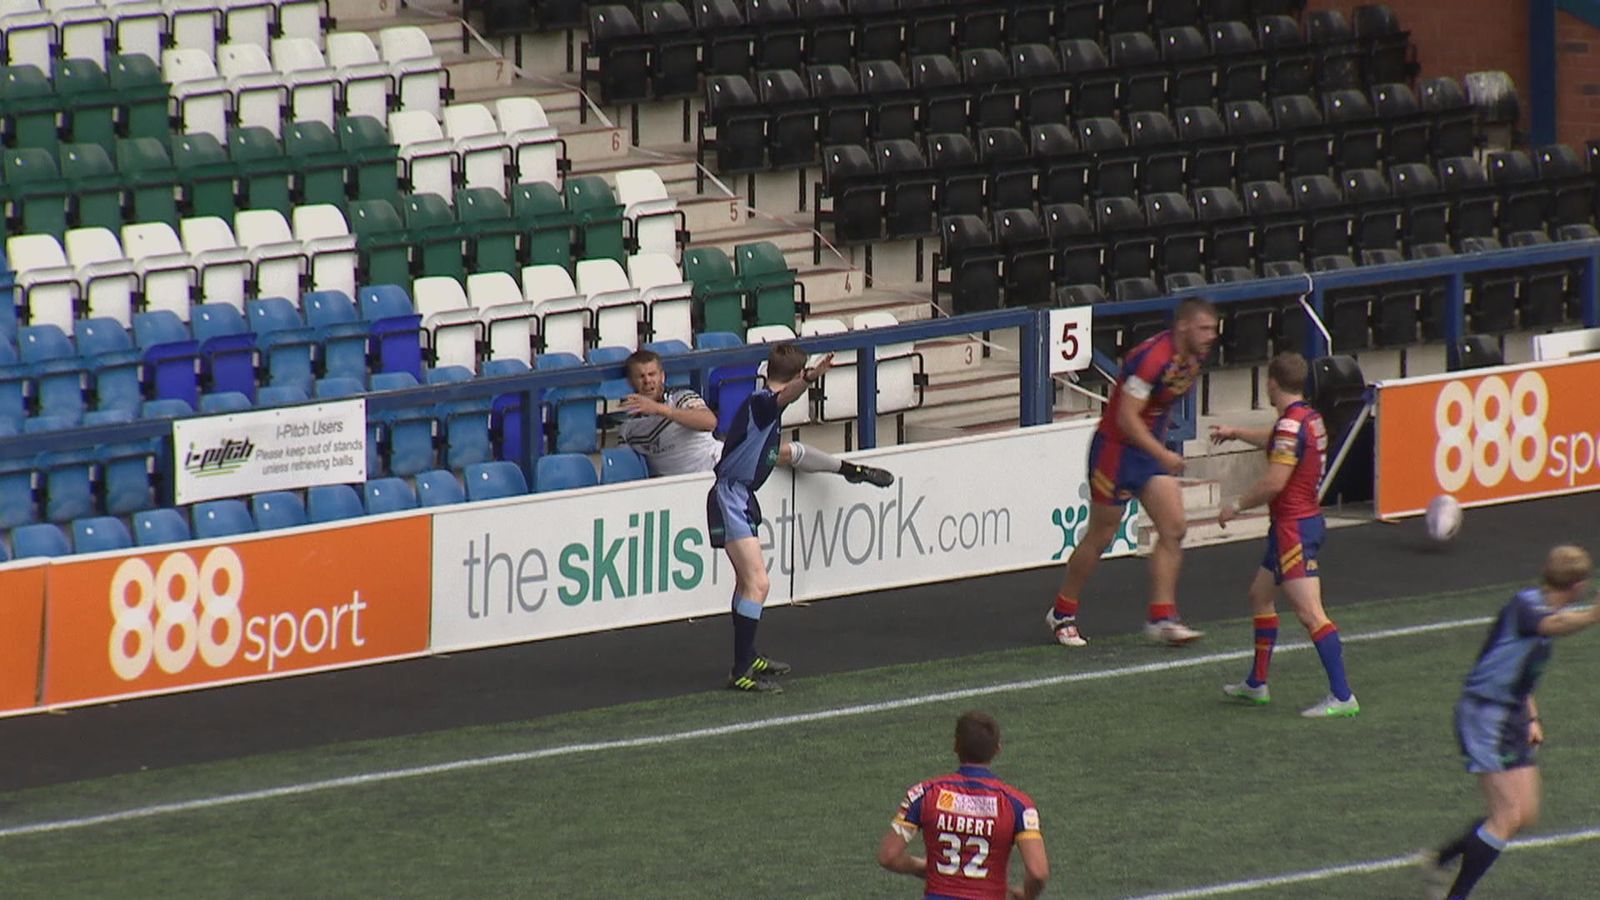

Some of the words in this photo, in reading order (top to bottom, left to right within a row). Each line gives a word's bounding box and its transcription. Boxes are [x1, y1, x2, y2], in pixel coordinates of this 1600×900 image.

[611, 132, 621, 152] 6
[728, 202, 739, 223] 5
[844, 272, 852, 293] 4
[1061, 322, 1079, 361] 5
[964, 346, 973, 366] 3
[312, 420, 344, 436] Users
[255, 448, 284, 462] Please
[286, 445, 306, 458] keep
[307, 443, 322, 456] out
[322, 441, 333, 453] of
[333, 439, 363, 453] stands
[262, 463, 289, 476] unless
[290, 457, 331, 472] retrieving
[332, 454, 354, 468] balls
[936, 813, 995, 836] ALBERT
[935, 832, 990, 879] 32
